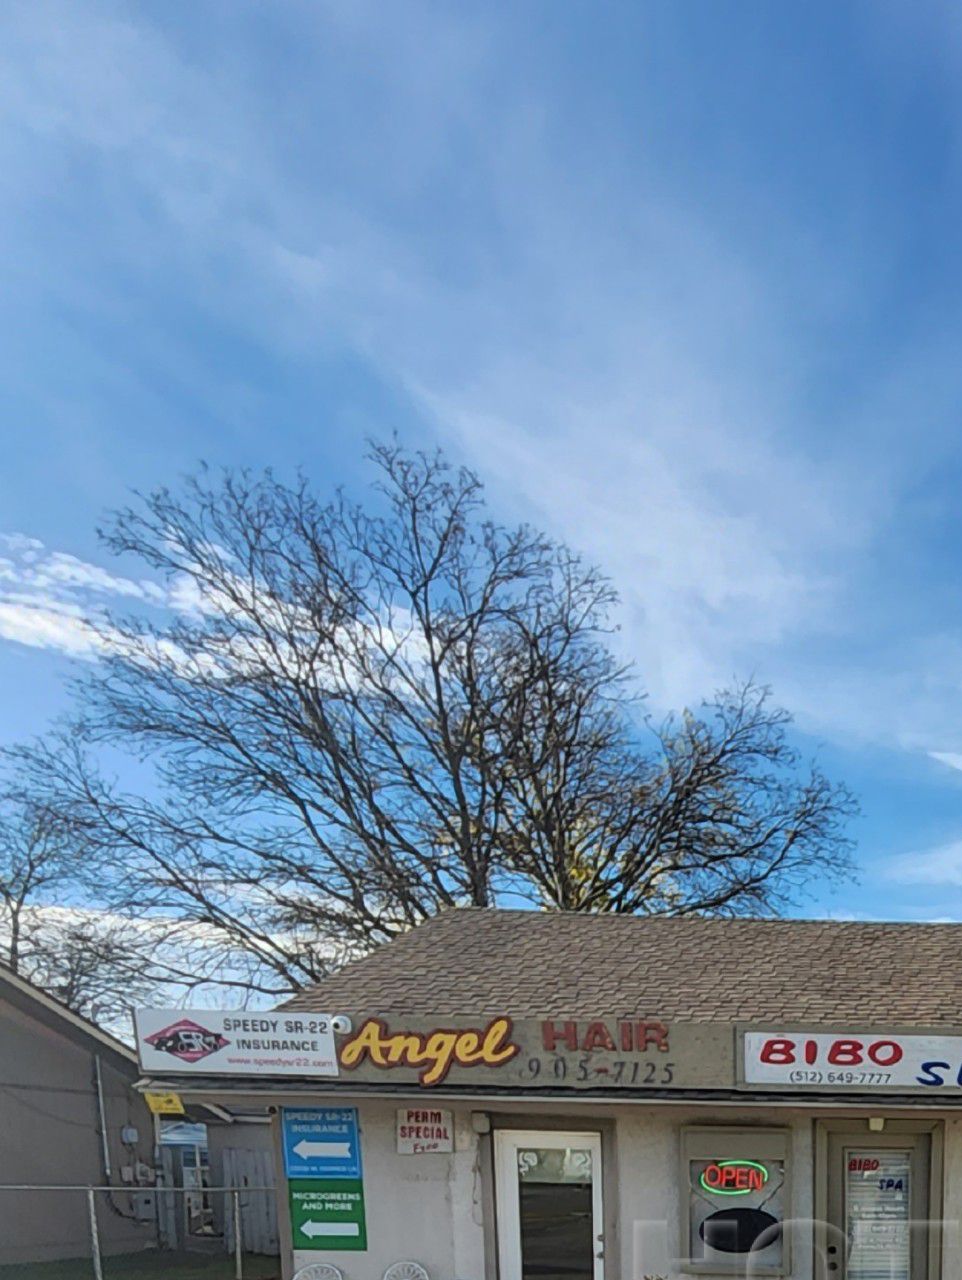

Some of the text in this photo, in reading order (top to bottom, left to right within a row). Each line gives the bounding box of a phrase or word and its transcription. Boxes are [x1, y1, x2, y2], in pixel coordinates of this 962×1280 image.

[223, 1018, 327, 1034] SPEEDY SR-22
[542, 1021, 669, 1052] HAIR
[236, 1039, 319, 1051] INSURANCE
[340, 1017, 517, 1085] Angel
[760, 1039, 903, 1066] BIBO
[789, 1071, 891, 1084] (512) 649-7777
[407, 1110, 442, 1123] PERM
[400, 1125, 449, 1140] SPECIAL
[848, 1158, 880, 1171] BIBO
[705, 1165, 763, 1190] OPEN
[878, 1178, 904, 1191] SPA
[301, 1202, 353, 1211] AND MORE
